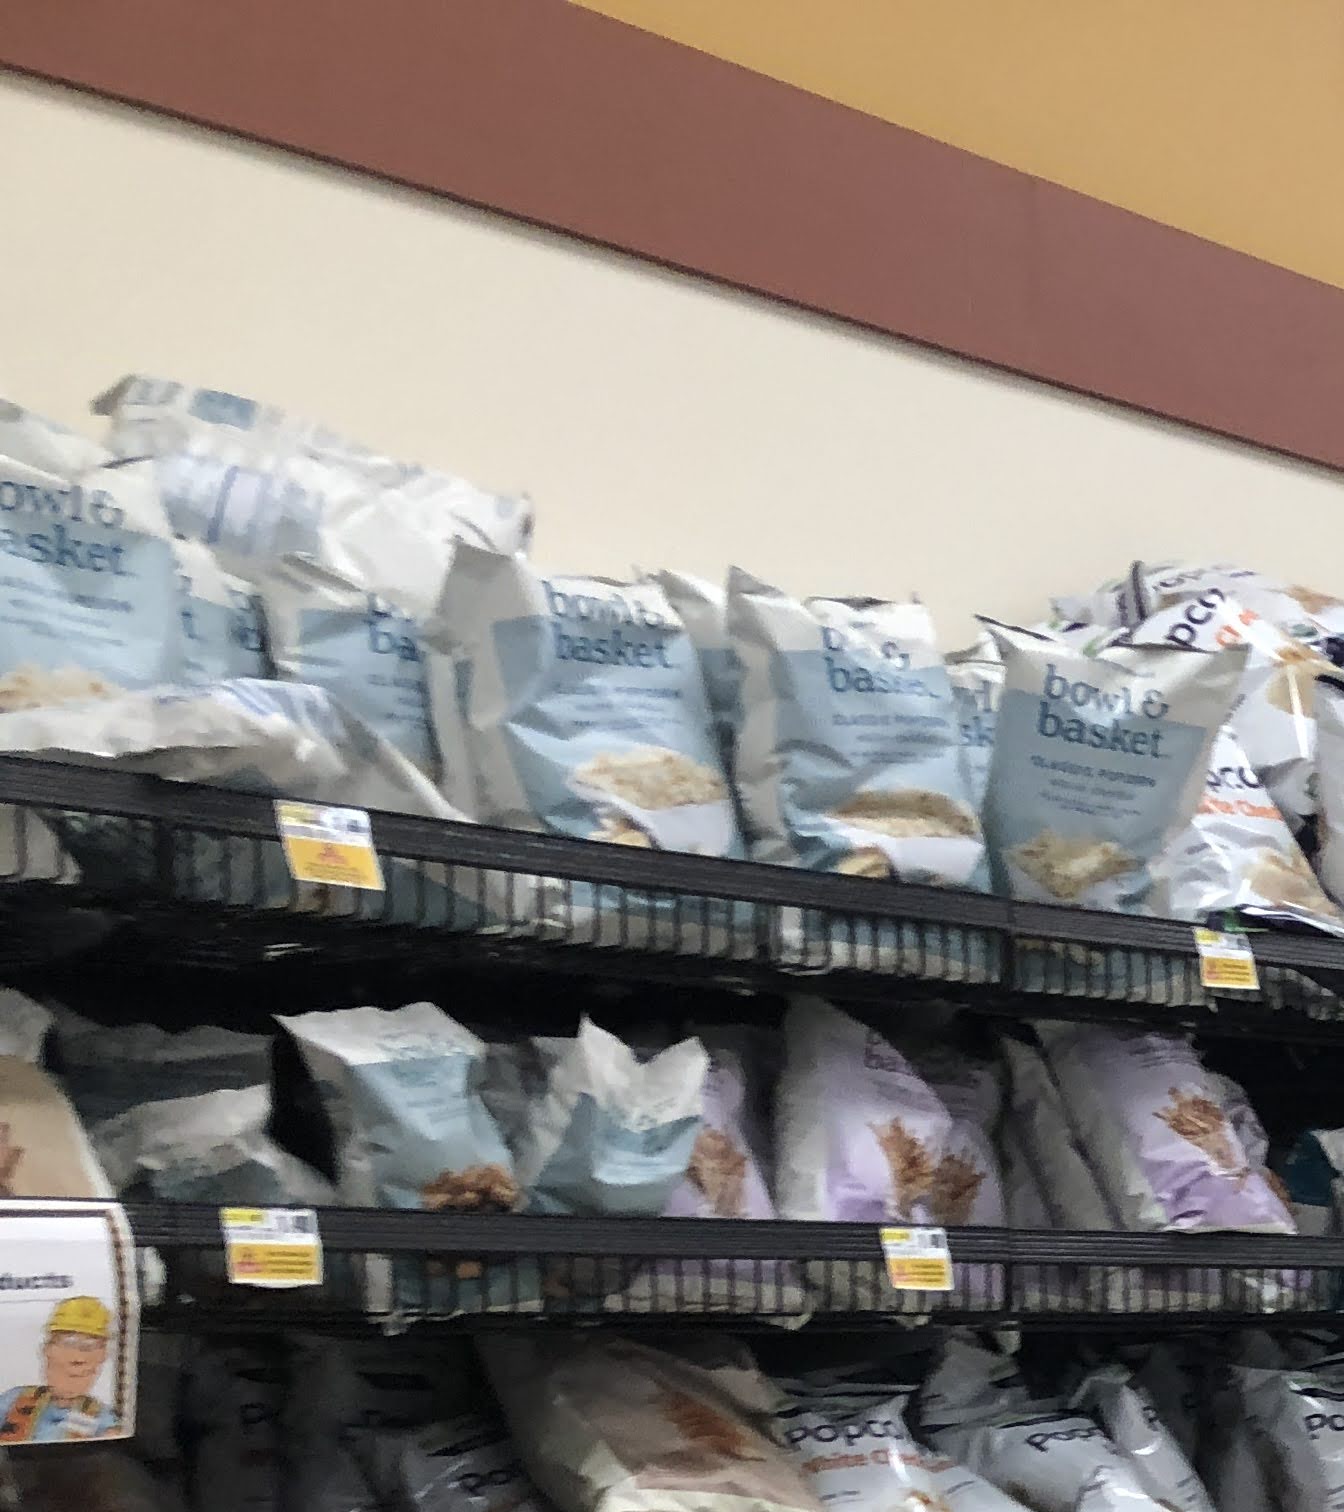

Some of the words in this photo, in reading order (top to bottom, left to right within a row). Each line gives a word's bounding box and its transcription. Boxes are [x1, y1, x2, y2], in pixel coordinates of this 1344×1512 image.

[0, 479, 85, 523] owl
[0, 523, 128, 577] asket
[1043, 662, 1134, 716] bowl
[1141, 686, 1171, 720] &
[1036, 700, 1172, 758] basket
